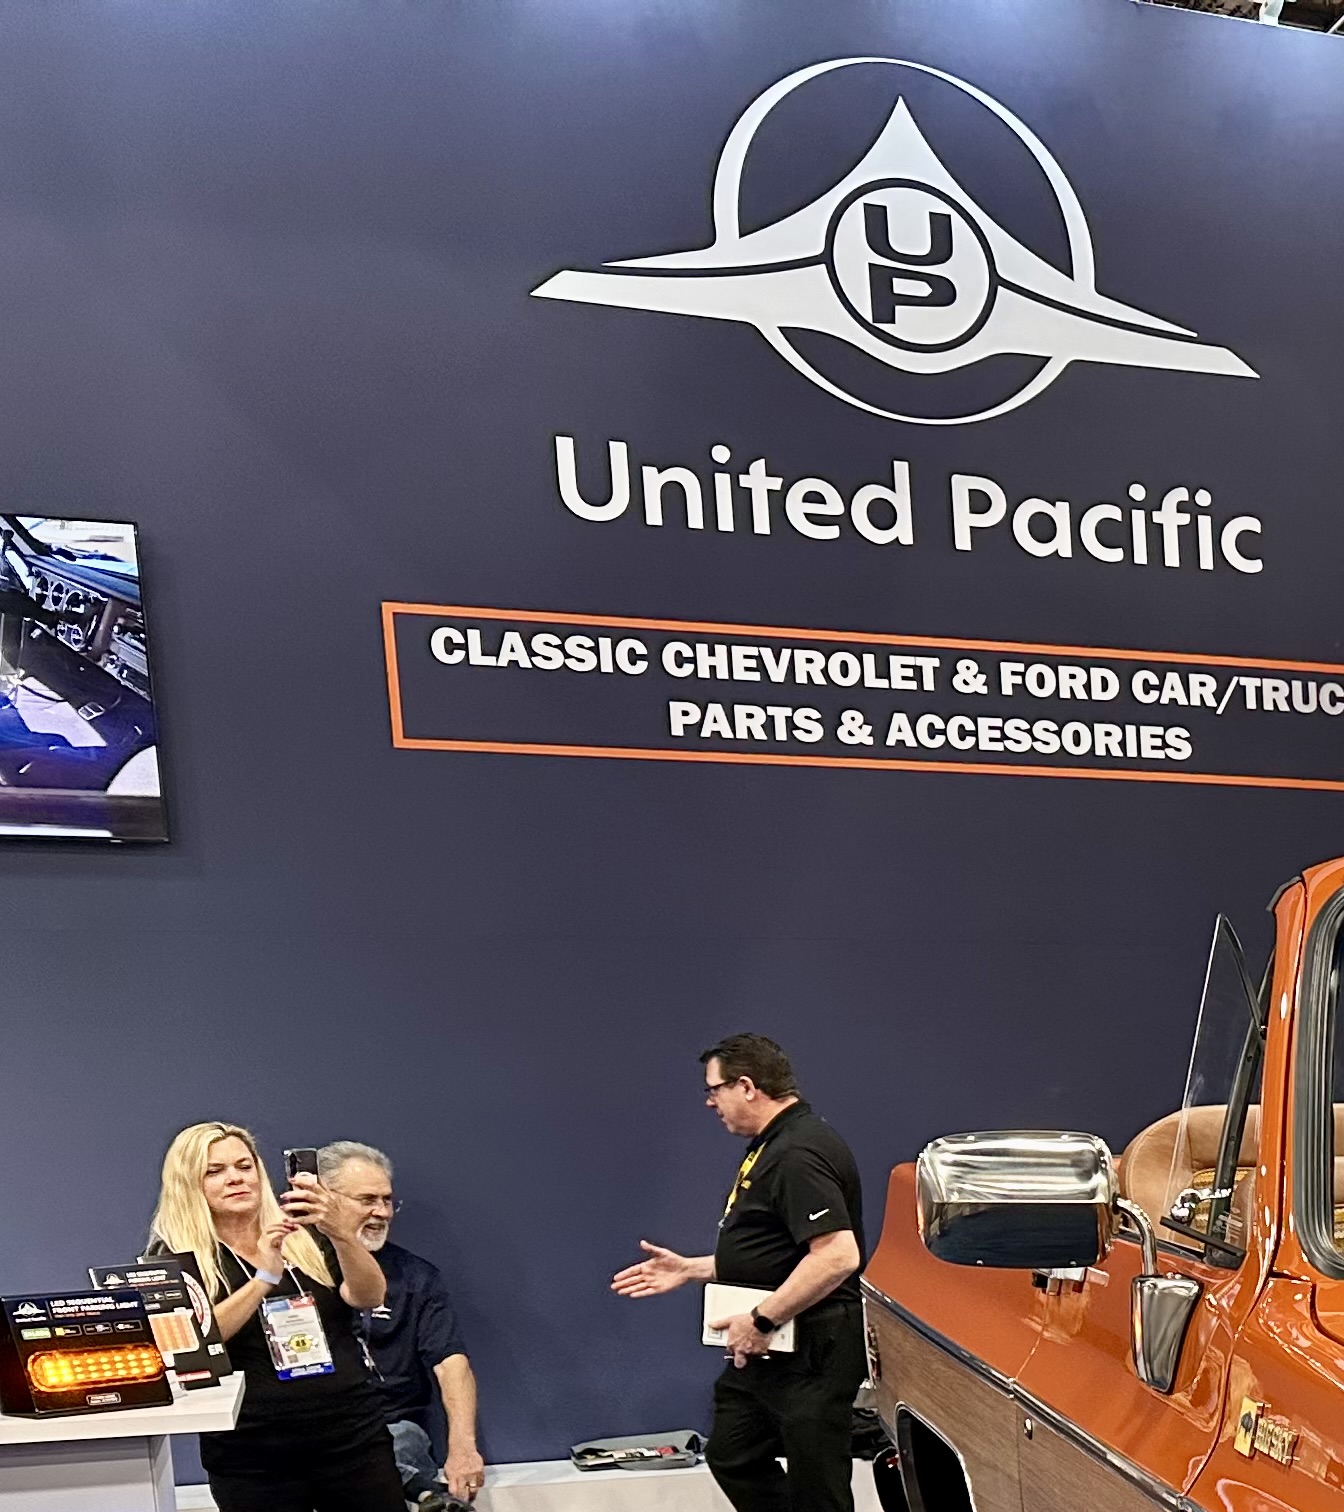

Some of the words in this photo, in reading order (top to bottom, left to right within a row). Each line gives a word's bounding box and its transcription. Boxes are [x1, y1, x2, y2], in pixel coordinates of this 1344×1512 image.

[554, 434, 915, 547] United
[950, 473, 1264, 575] Pacific
[429, 626, 649, 677] CLASSIC
[661, 640, 940, 694] CHEVROLET
[951, 659, 988, 695] &
[1000, 661, 1120, 704] FORD
[668, 700, 824, 746] PARTS
[836, 709, 874, 747] &
[886, 710, 1193, 762] ACCESSORIES
